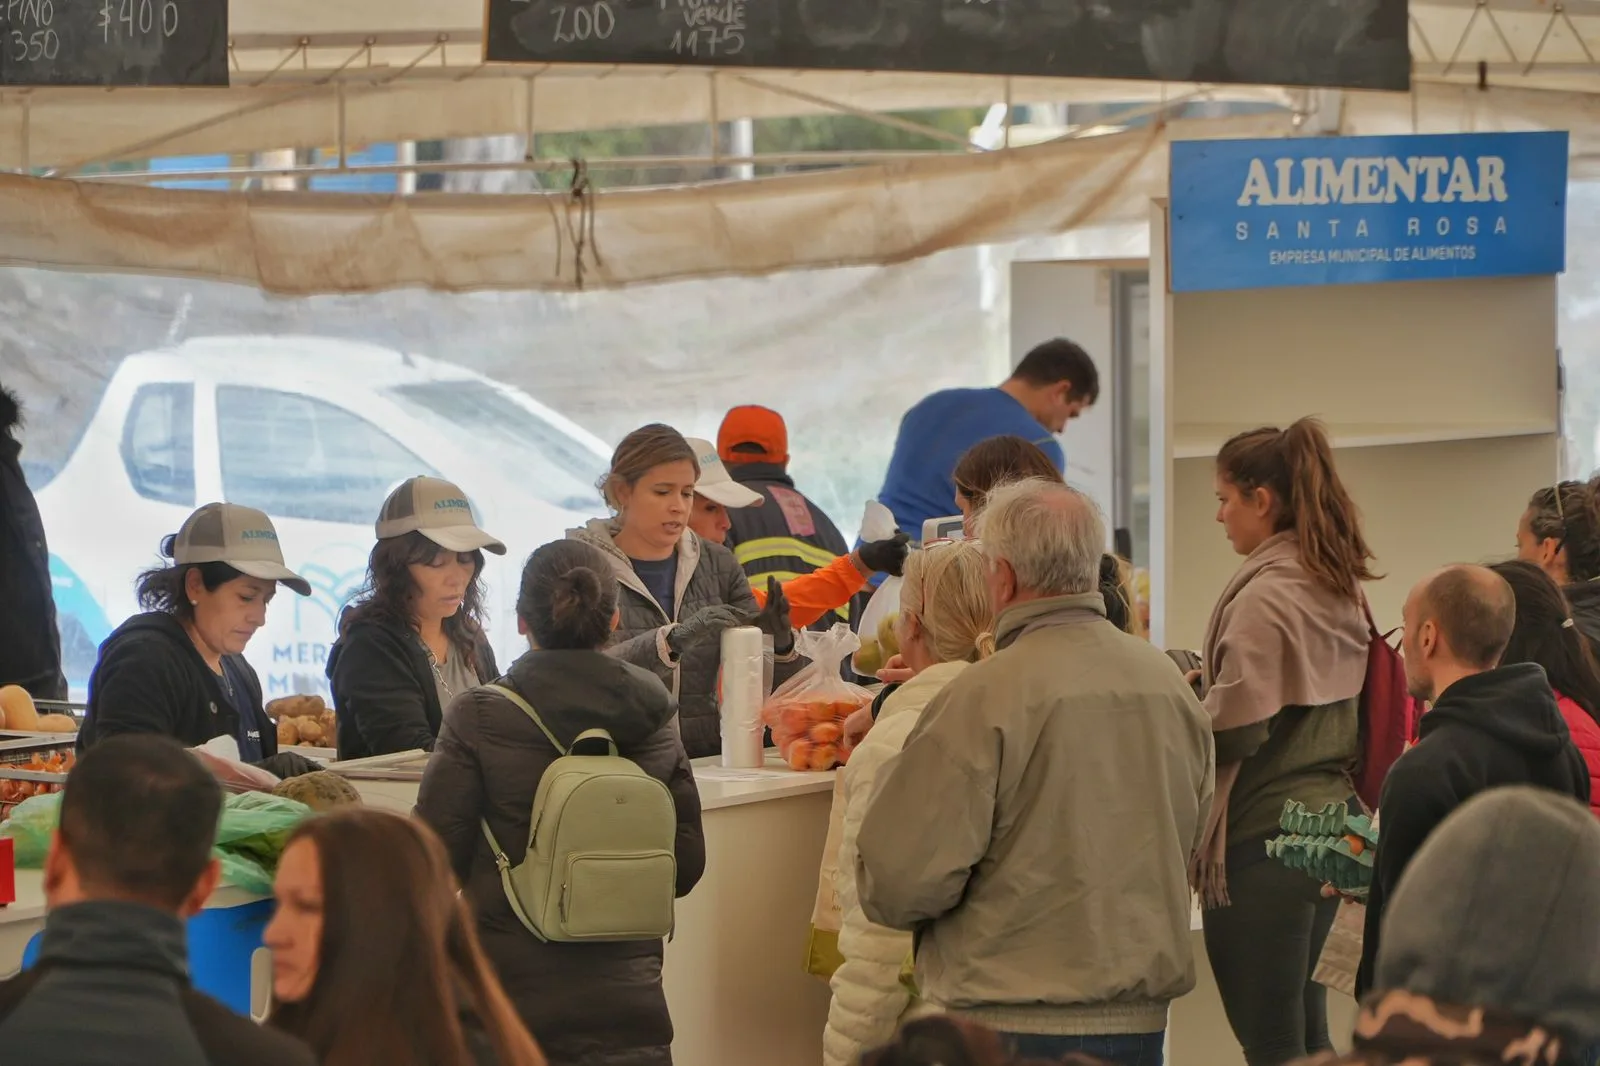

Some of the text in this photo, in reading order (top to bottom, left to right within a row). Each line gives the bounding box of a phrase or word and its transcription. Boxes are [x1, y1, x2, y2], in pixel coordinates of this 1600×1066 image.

[97, 0, 179, 44] $400
[550, 2, 616, 43] 200
[11, 29, 60, 62] 350
[669, 25, 746, 57] 1175
[1236, 155, 1508, 208] ALIMENTAR
[1235, 216, 1507, 241] SANTA ROSA
[1269, 245, 1476, 265] EMPRESA MUNICIPAL DE ALIMENTOS
